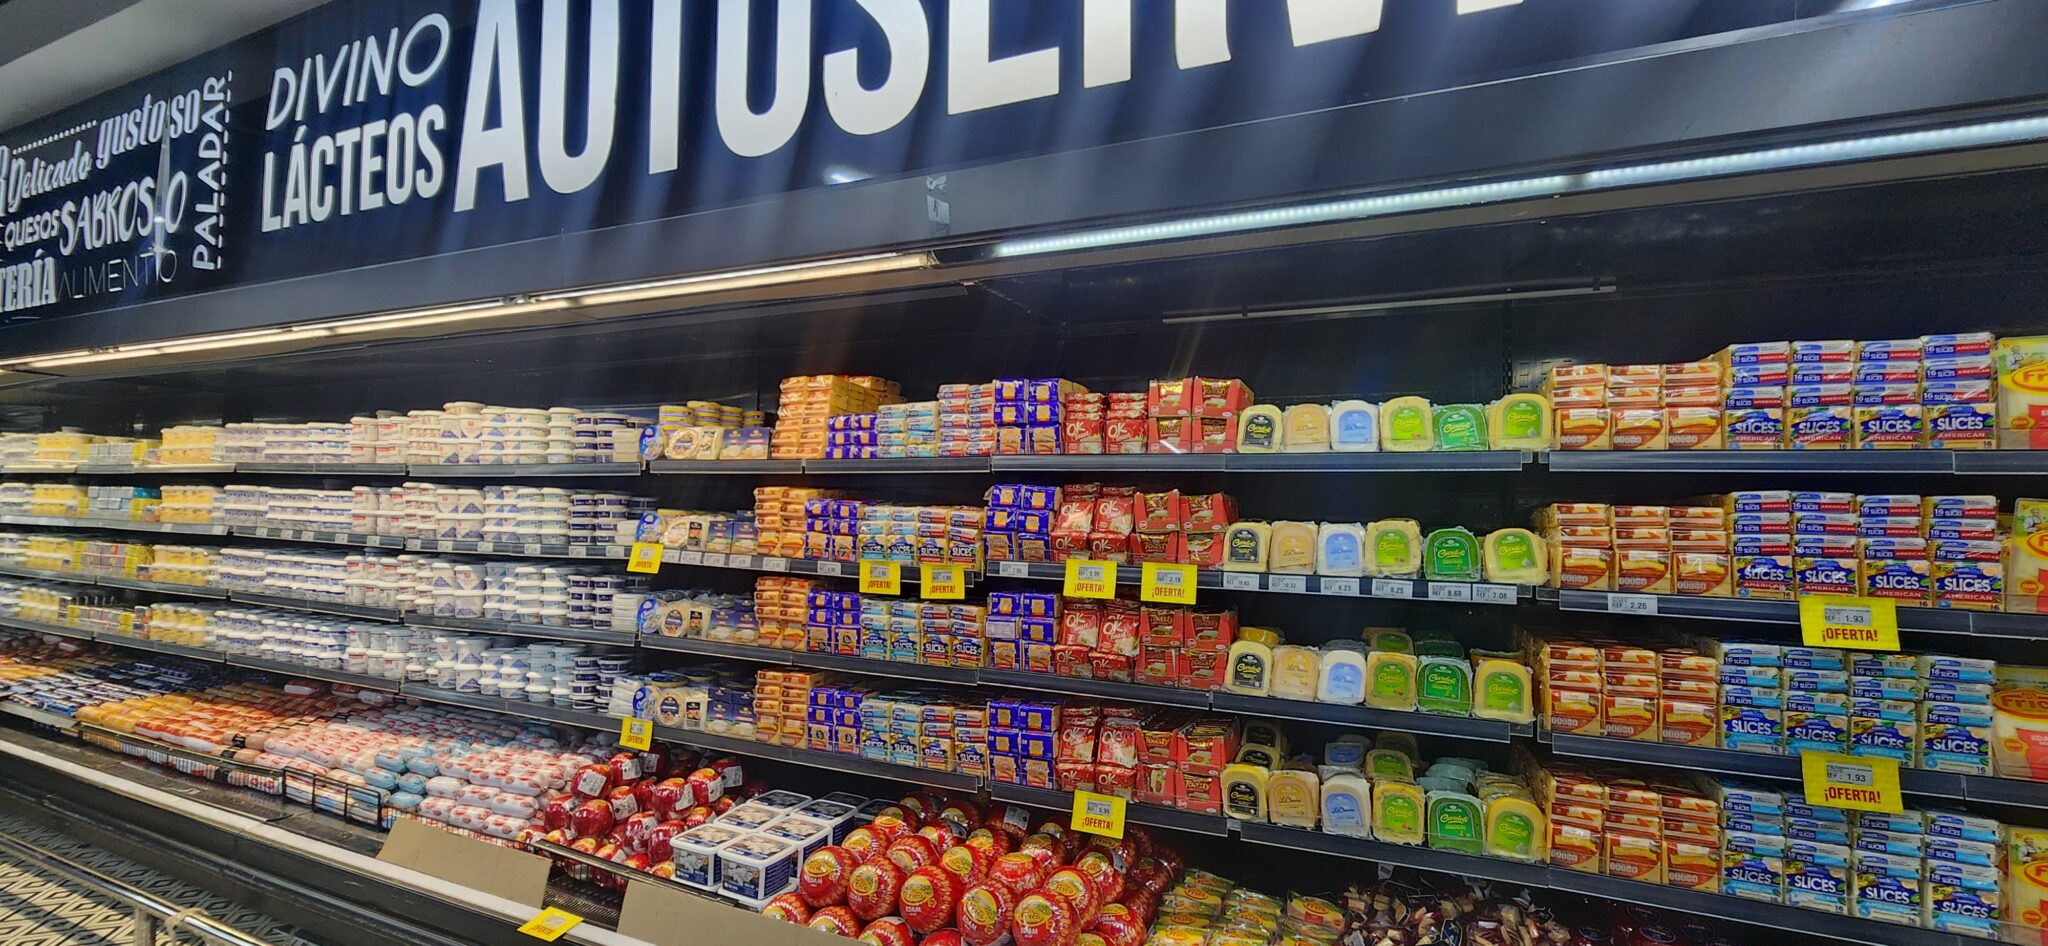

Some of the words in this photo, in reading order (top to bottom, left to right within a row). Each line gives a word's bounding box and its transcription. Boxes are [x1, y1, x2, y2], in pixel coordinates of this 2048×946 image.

[265, 12, 450, 131] DIVINO
[191, 76, 227, 270] PALADAR
[261, 104, 446, 233] LÁCTEOS
[8, 140, 92, 213] Delicado
[59, 171, 187, 256] SABROSO
[4, 209, 60, 251] QUESOS
[1066, 421, 1086, 436] OK
[1108, 423, 1128, 438] OK
[1736, 421, 1775, 434] SLICES
[1799, 421, 1840, 433] SLICES
[1868, 420, 1912, 432] SLICES
[1937, 417, 1983, 430] SLICES
[1100, 501, 1119, 515] OK
[1871, 507, 1888, 515] SLICES
[1056, 537, 1075, 550] OK
[1092, 539, 1112, 552] OK
[952, 547, 972, 557] SLICES
[1745, 567, 1785, 580] SLICES
[1805, 570, 1847, 583] SLICES
[1074, 583, 1105, 593] ¡OFERTA!
[1876, 576, 1919, 589] SLICES
[1944, 578, 1991, 592] SLICES
[1152, 587, 1185, 598] ¡OFERTA!
[1493, 592, 1508, 600] 7.08
[1630, 602, 1647, 610] 2.25
[1066, 613, 1086, 628] OK
[1845, 615, 1864, 623] 1.93
[1103, 621, 1124, 636] OK
[1822, 627, 1878, 642] ¡OFERTA!
[1056, 649, 1076, 663] OK
[1732, 720, 1772, 735] SLICES
[1795, 728, 1836, 742] SLICES
[1933, 739, 1979, 754] SLICES
[1099, 772, 1118, 785] OK
[1847, 773, 1866, 783] 1.93
[1824, 786, 1881, 803] ¡OFERTA!
[1082, 816, 1114, 831] ¡OFERTA!
[1732, 868, 1772, 884] SLICES
[1795, 875, 1836, 893] SLICES
[1866, 886, 1910, 904] SLICES
[1942, 901, 1989, 919] SLICES
